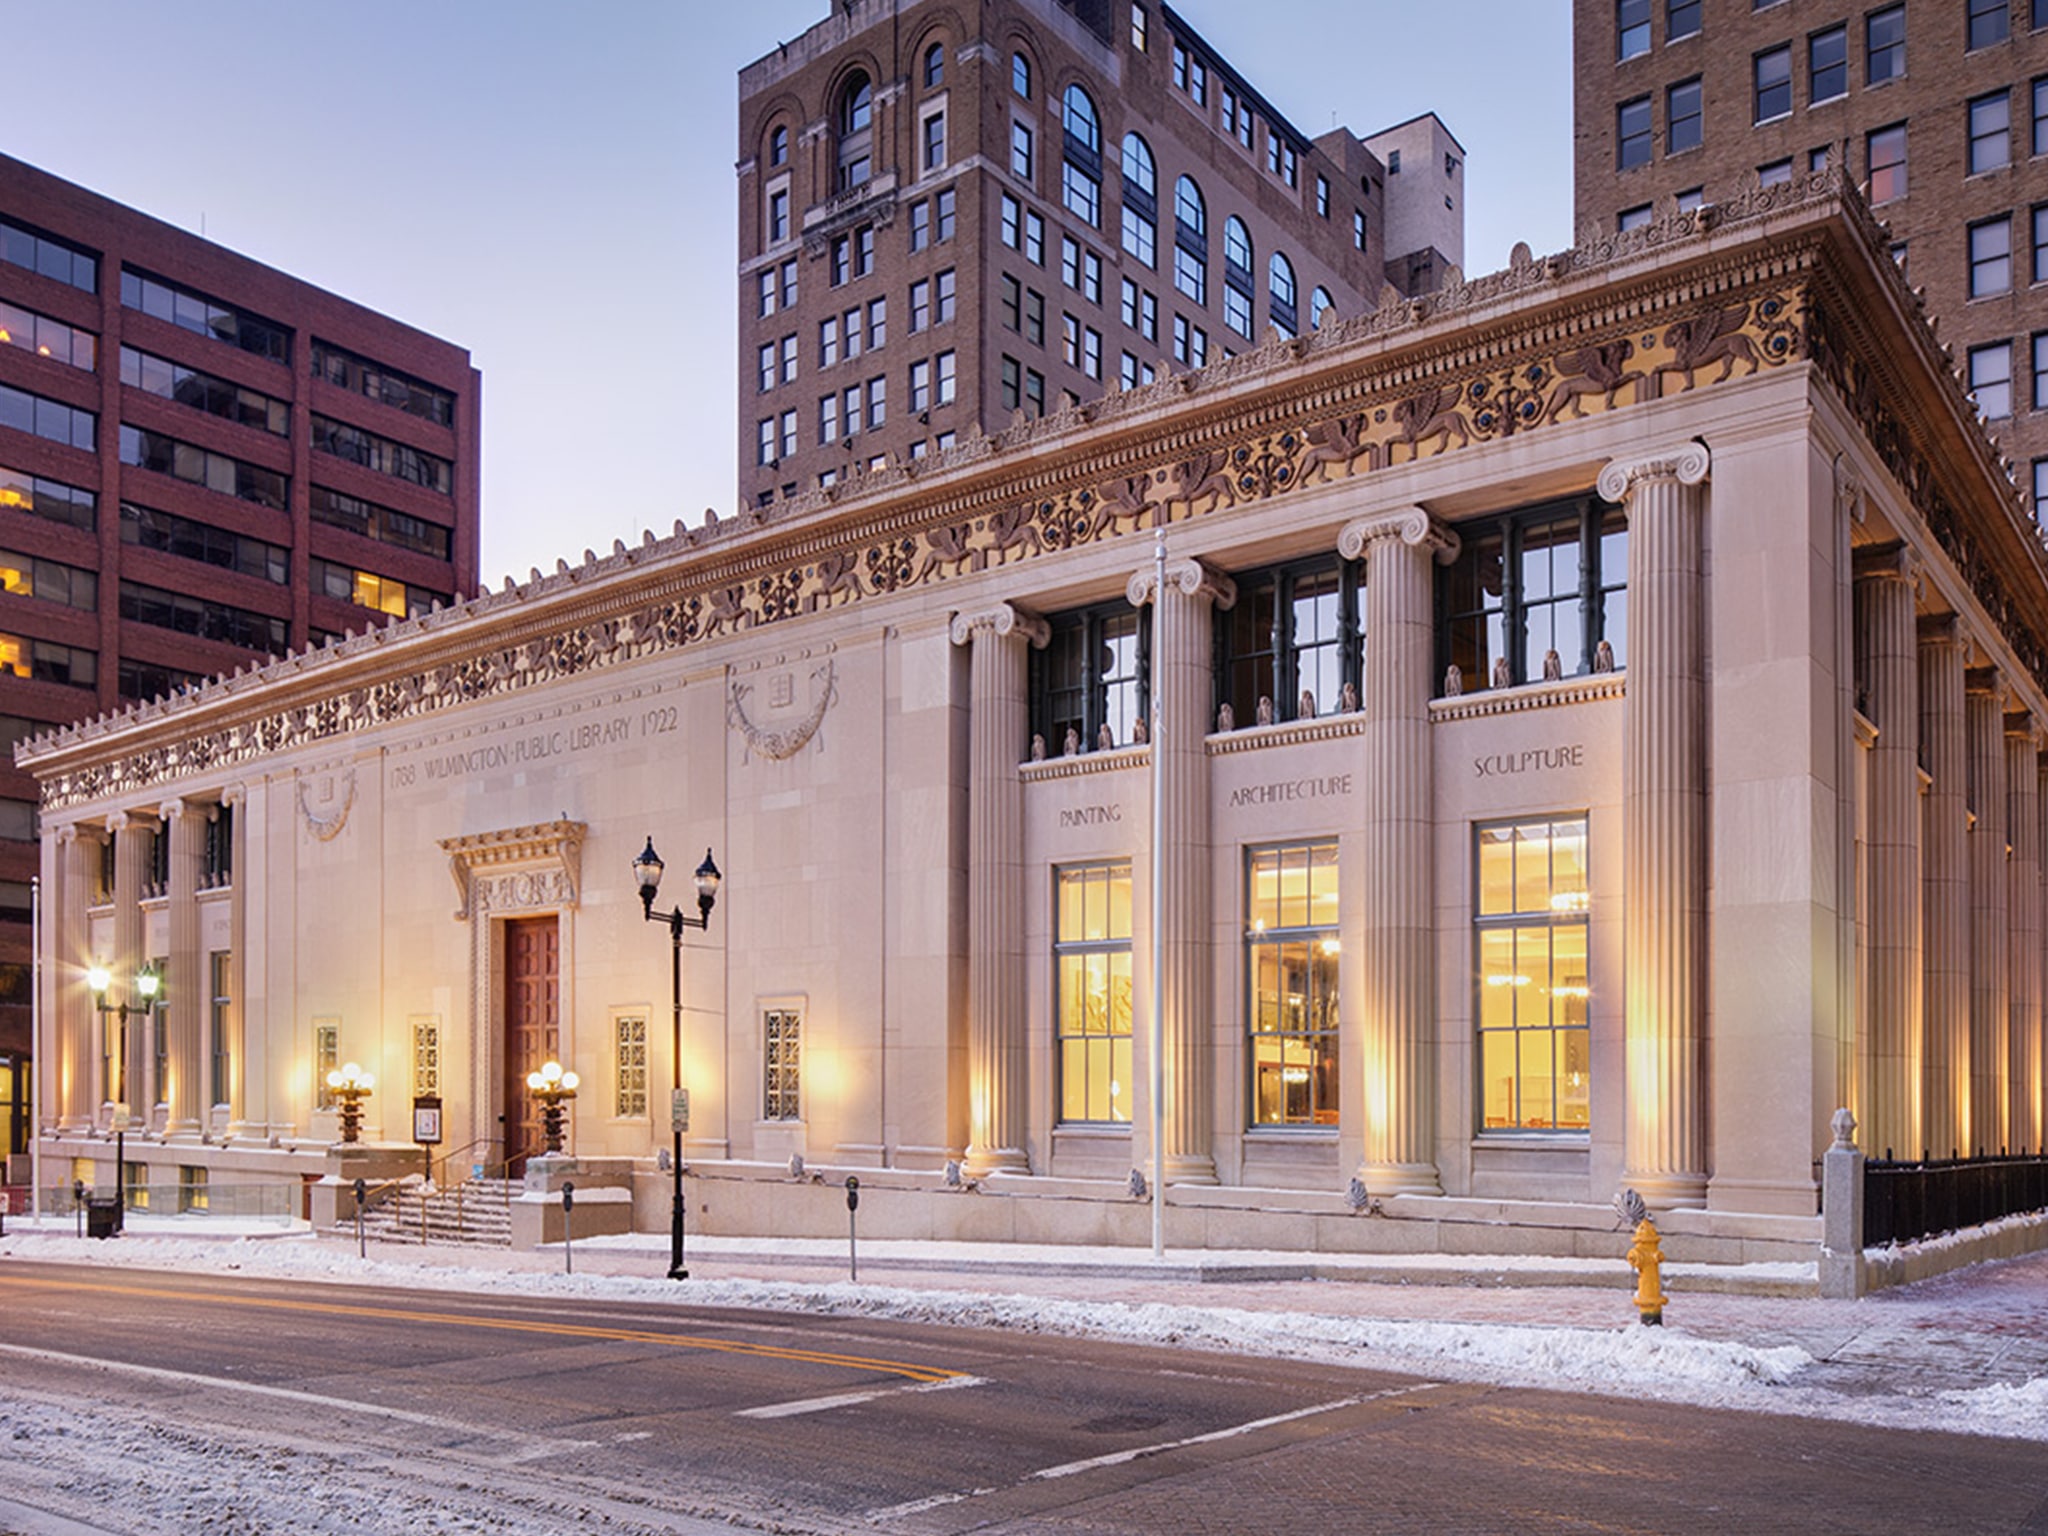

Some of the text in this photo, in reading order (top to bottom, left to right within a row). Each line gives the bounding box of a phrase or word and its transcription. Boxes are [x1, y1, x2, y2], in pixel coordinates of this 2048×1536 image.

[424, 743, 509, 779] WILMINGTON
[515, 731, 562, 763] PUBLIC
[569, 715, 632, 751] LIBRARY
[641, 706, 678, 737] 1922
[1474, 744, 1583, 778] SCULPTURE
[1229, 774, 1352, 807] ARCHITECTURE
[1060, 803, 1121, 828] PAINTING
